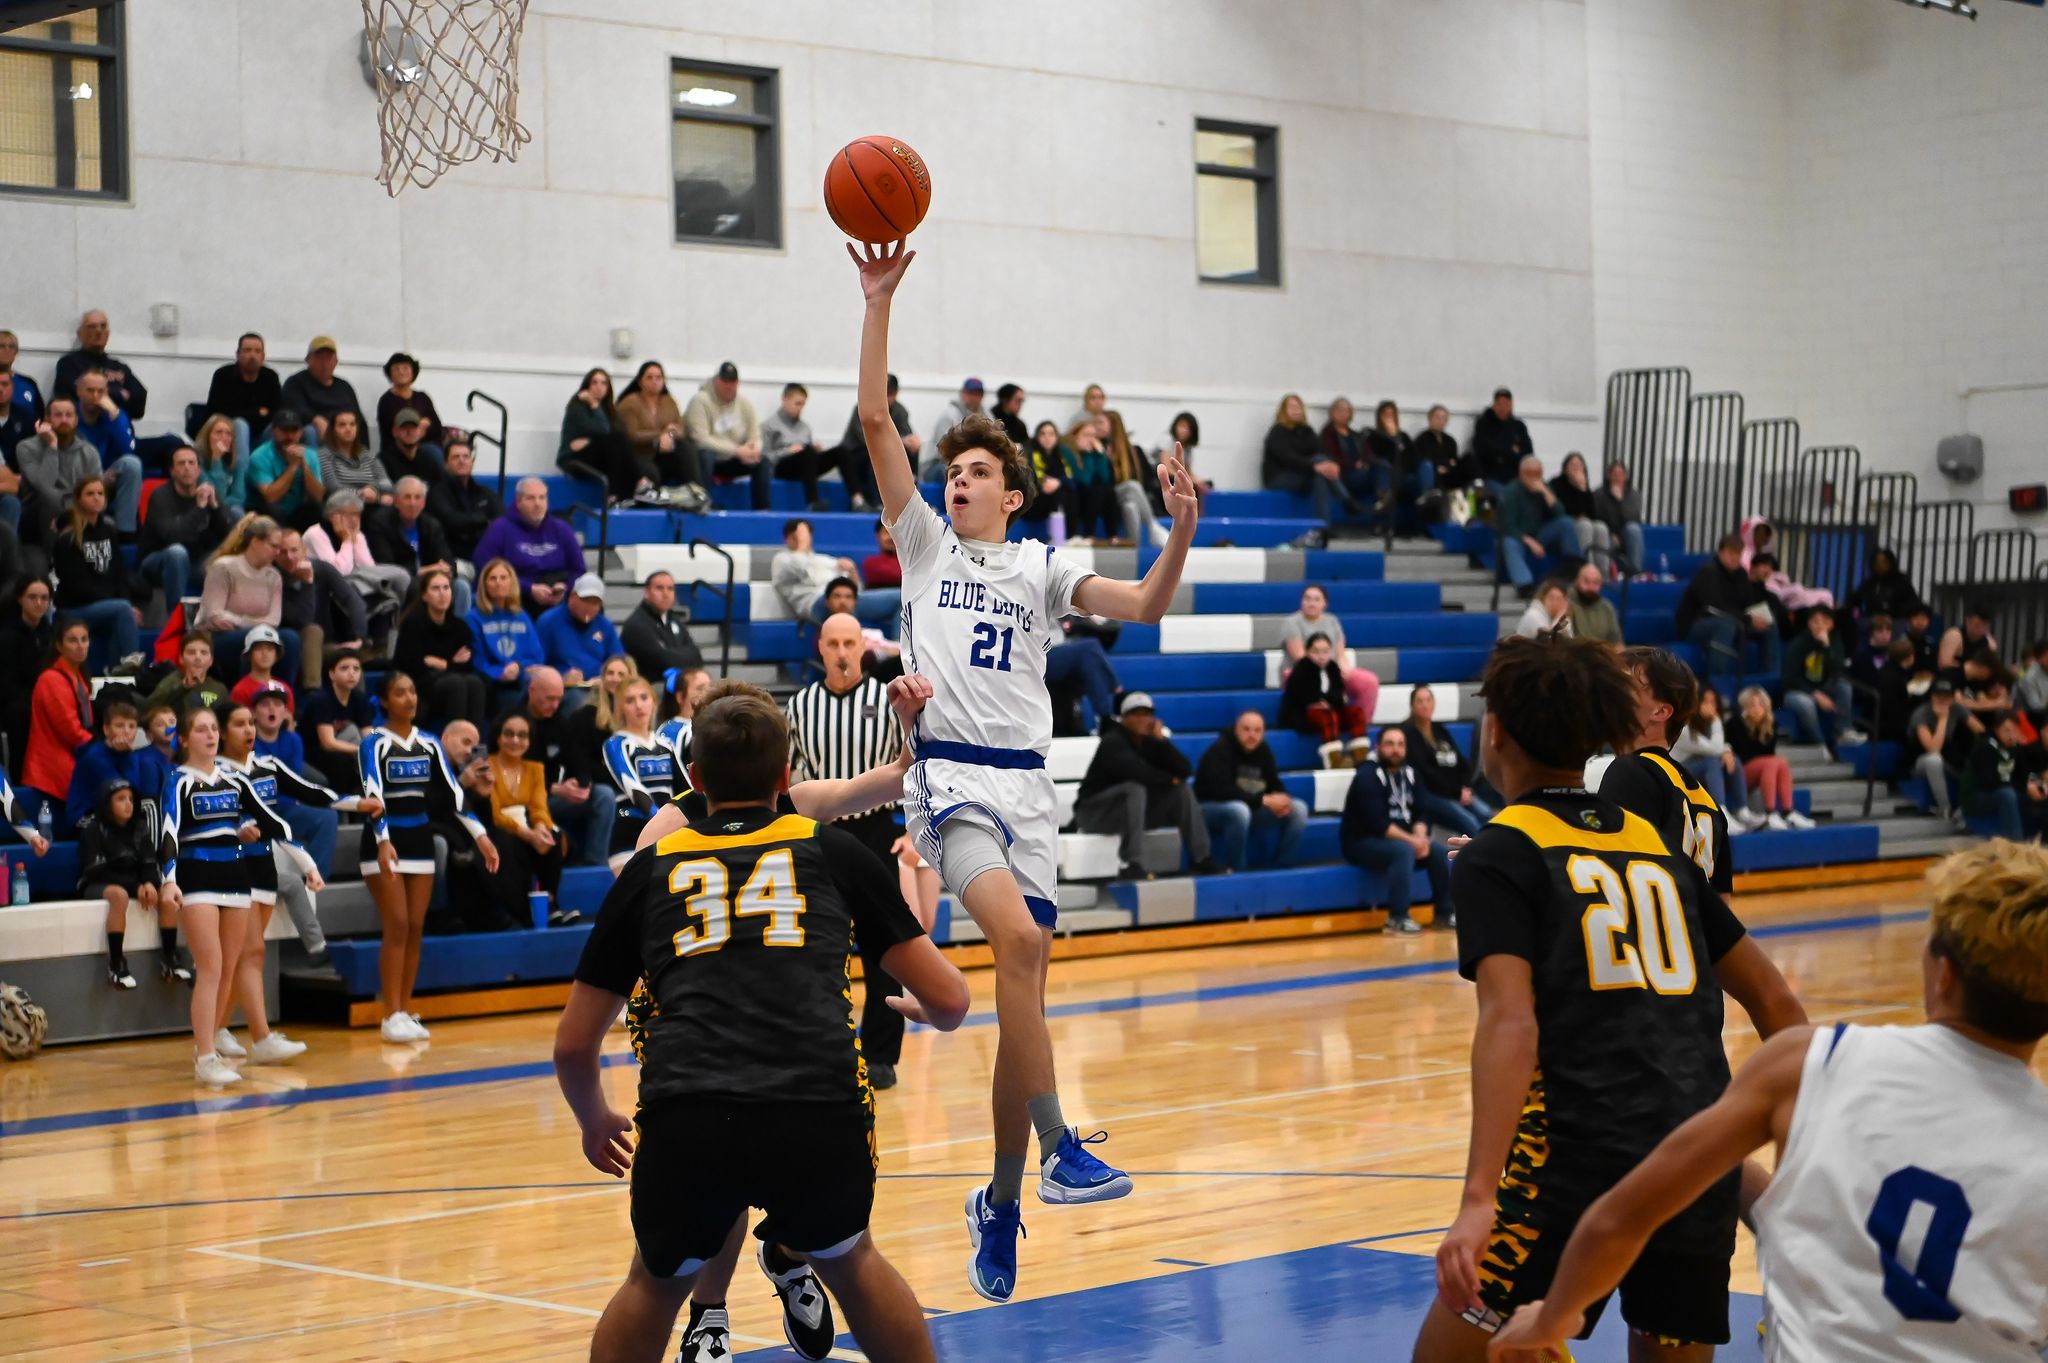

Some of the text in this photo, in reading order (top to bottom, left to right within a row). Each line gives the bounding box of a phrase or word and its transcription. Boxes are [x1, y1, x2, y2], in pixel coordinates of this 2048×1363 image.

[938, 580, 986, 612] BLUE
[970, 621, 1014, 672] 21
[669, 848, 806, 957] 34
[1567, 854, 1697, 995] 20
[1867, 1165, 1972, 1322] 0
